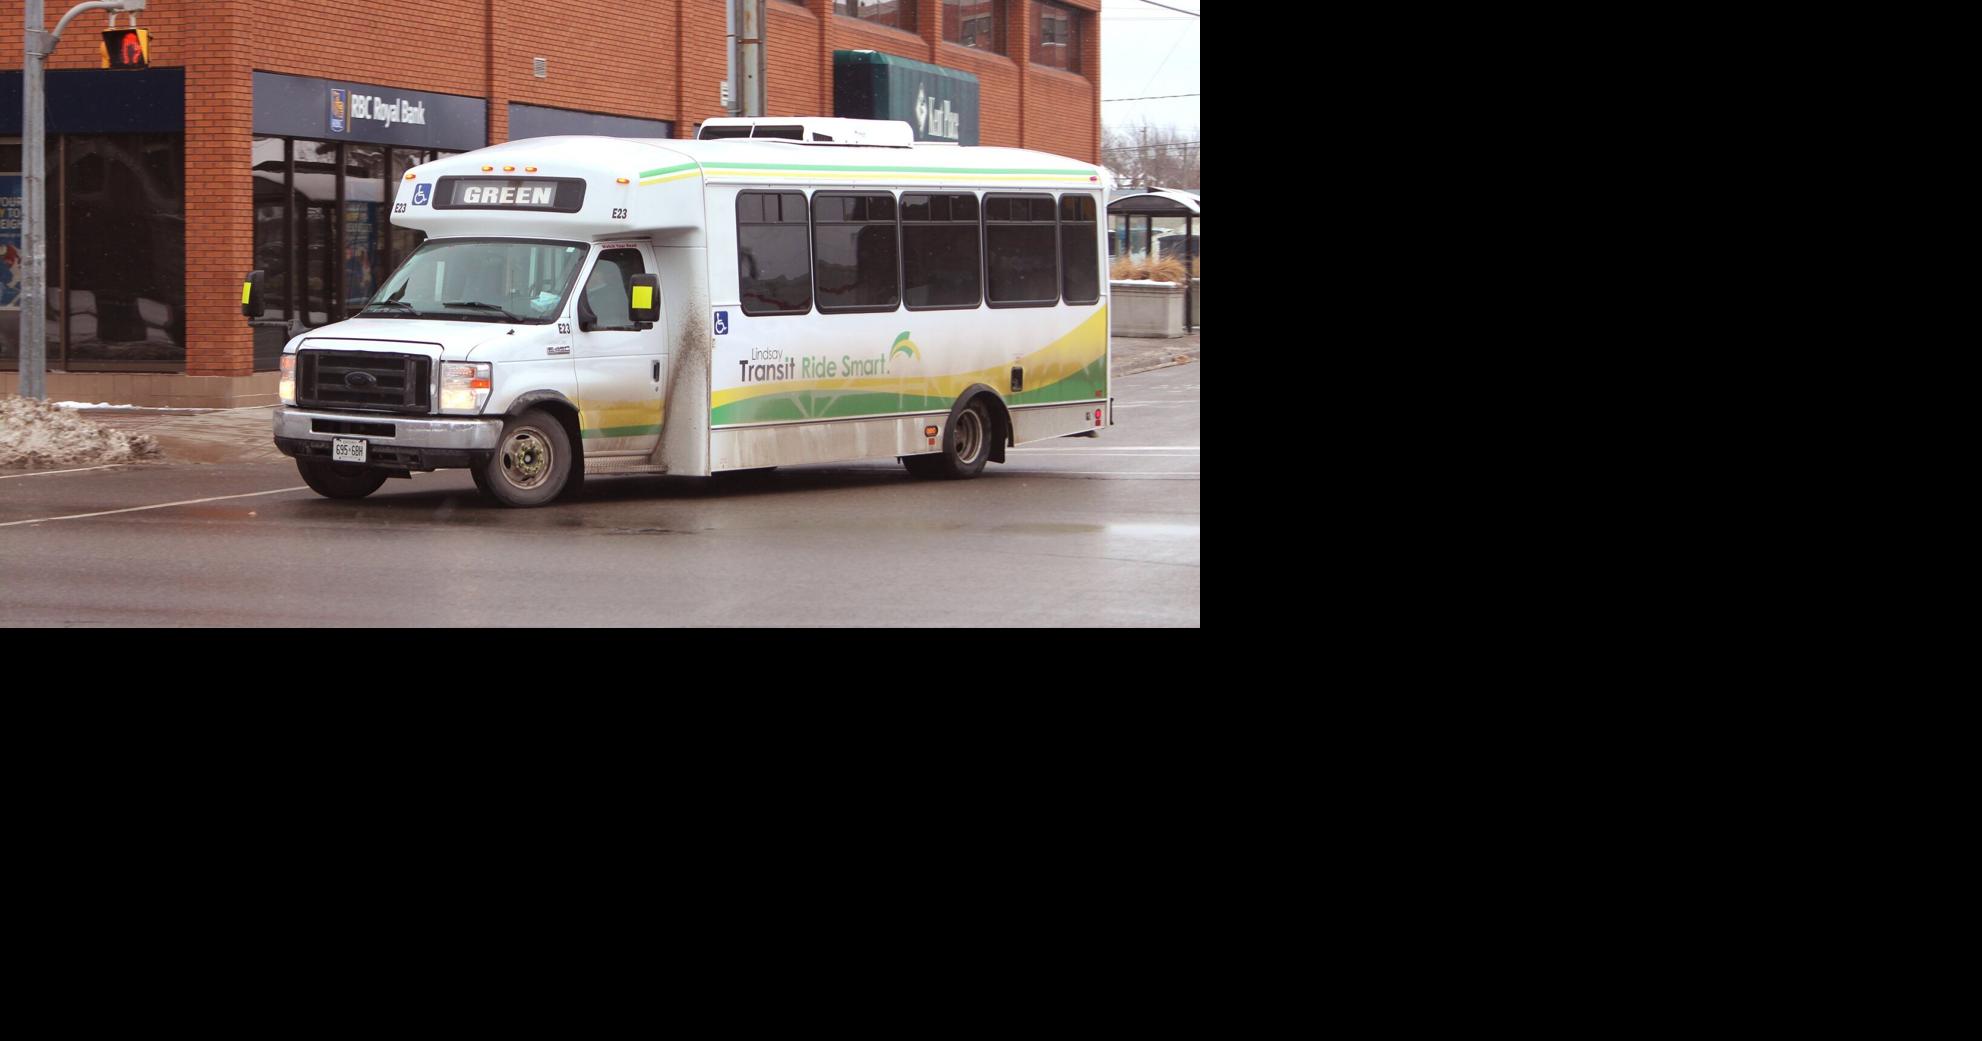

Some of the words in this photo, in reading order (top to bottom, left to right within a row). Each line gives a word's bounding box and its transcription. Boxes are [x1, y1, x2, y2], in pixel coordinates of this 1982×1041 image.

[351, 94, 372, 119] RBC
[373, 97, 400, 128] Royal
[402, 100, 426, 125] Bank
[463, 186, 553, 205] GREEN
[395, 203, 407, 214] E23
[611, 208, 628, 219] E23
[558, 323, 570, 334] E23
[751, 347, 783, 361] Lindsay
[739, 357, 795, 382] Transit
[802, 356, 837, 378] Ride
[842, 353, 890, 377] Smart.
